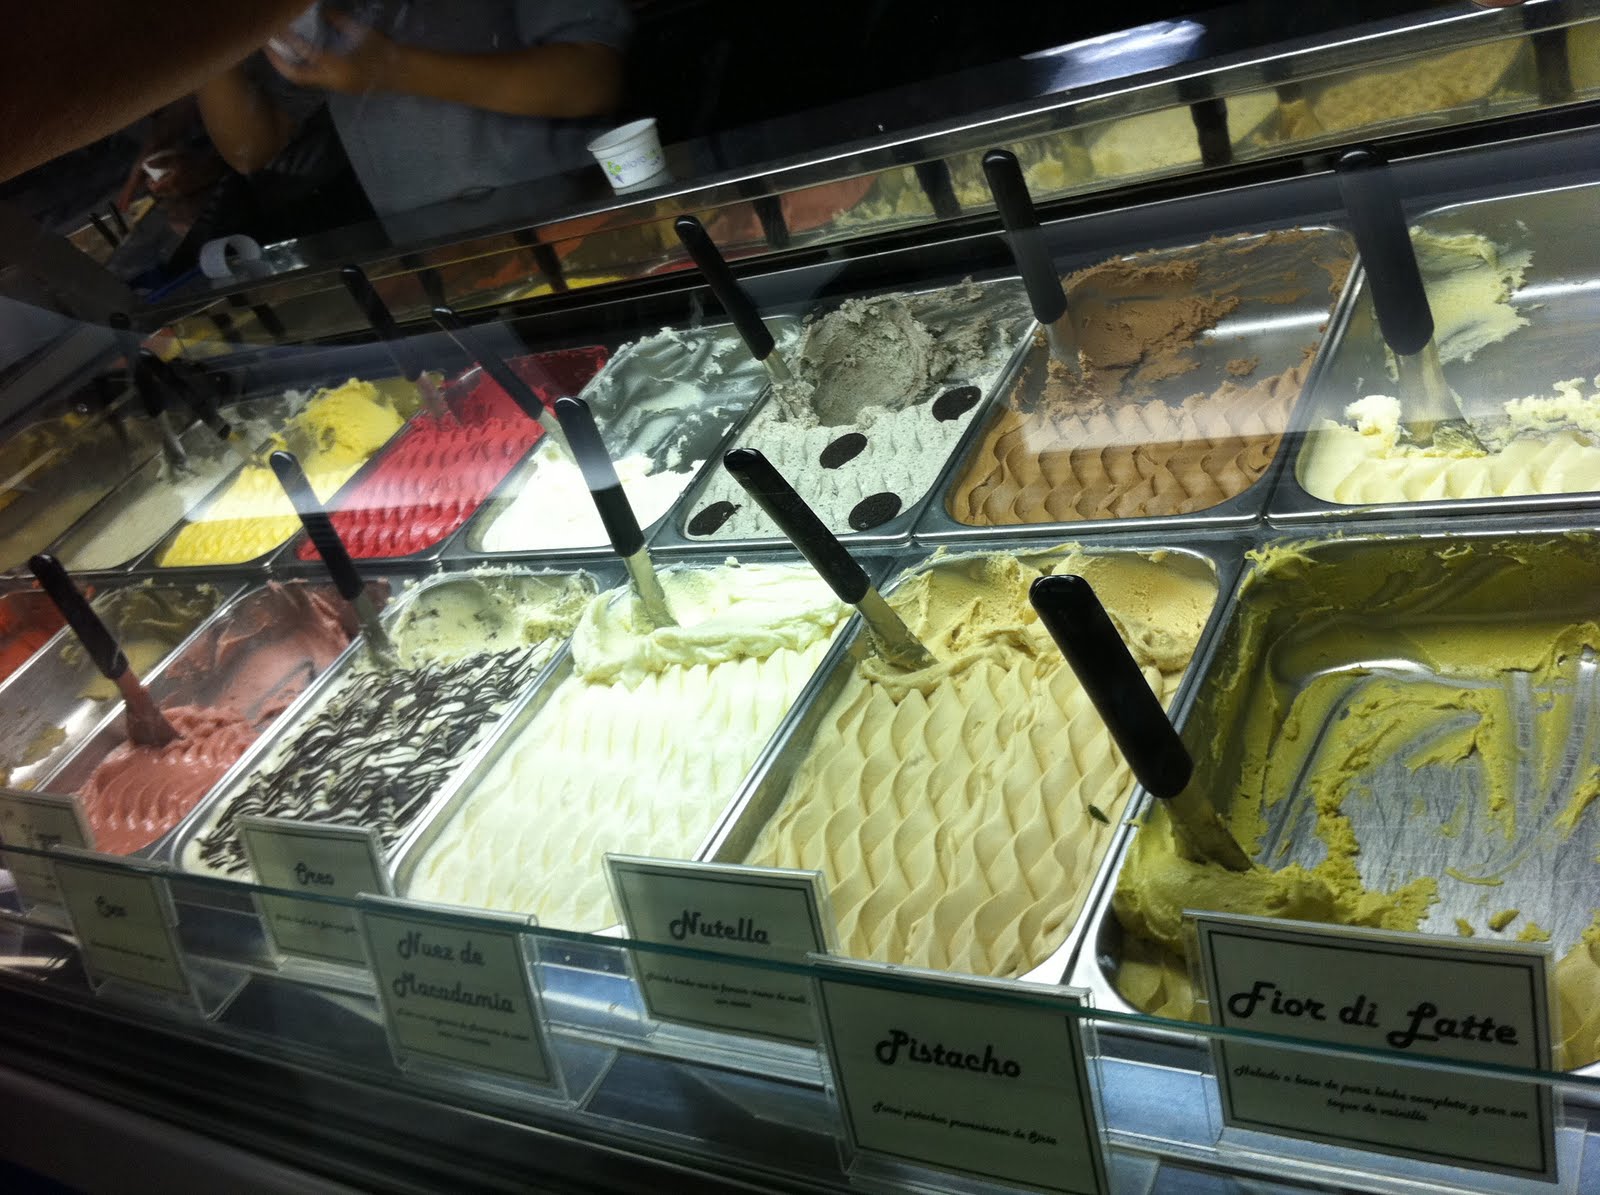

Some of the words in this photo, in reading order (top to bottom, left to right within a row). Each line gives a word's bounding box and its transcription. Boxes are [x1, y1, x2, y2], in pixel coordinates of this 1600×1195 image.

[669, 909, 770, 944] Nutella
[397, 931, 455, 960] Nuez
[460, 940, 486, 965] de
[393, 971, 515, 1013] Macadamia
[1227, 981, 1326, 1020] Fior
[1339, 995, 1379, 1028] di
[1386, 1002, 1518, 1048] Latte
[874, 1029, 1021, 1078] Pistacho
